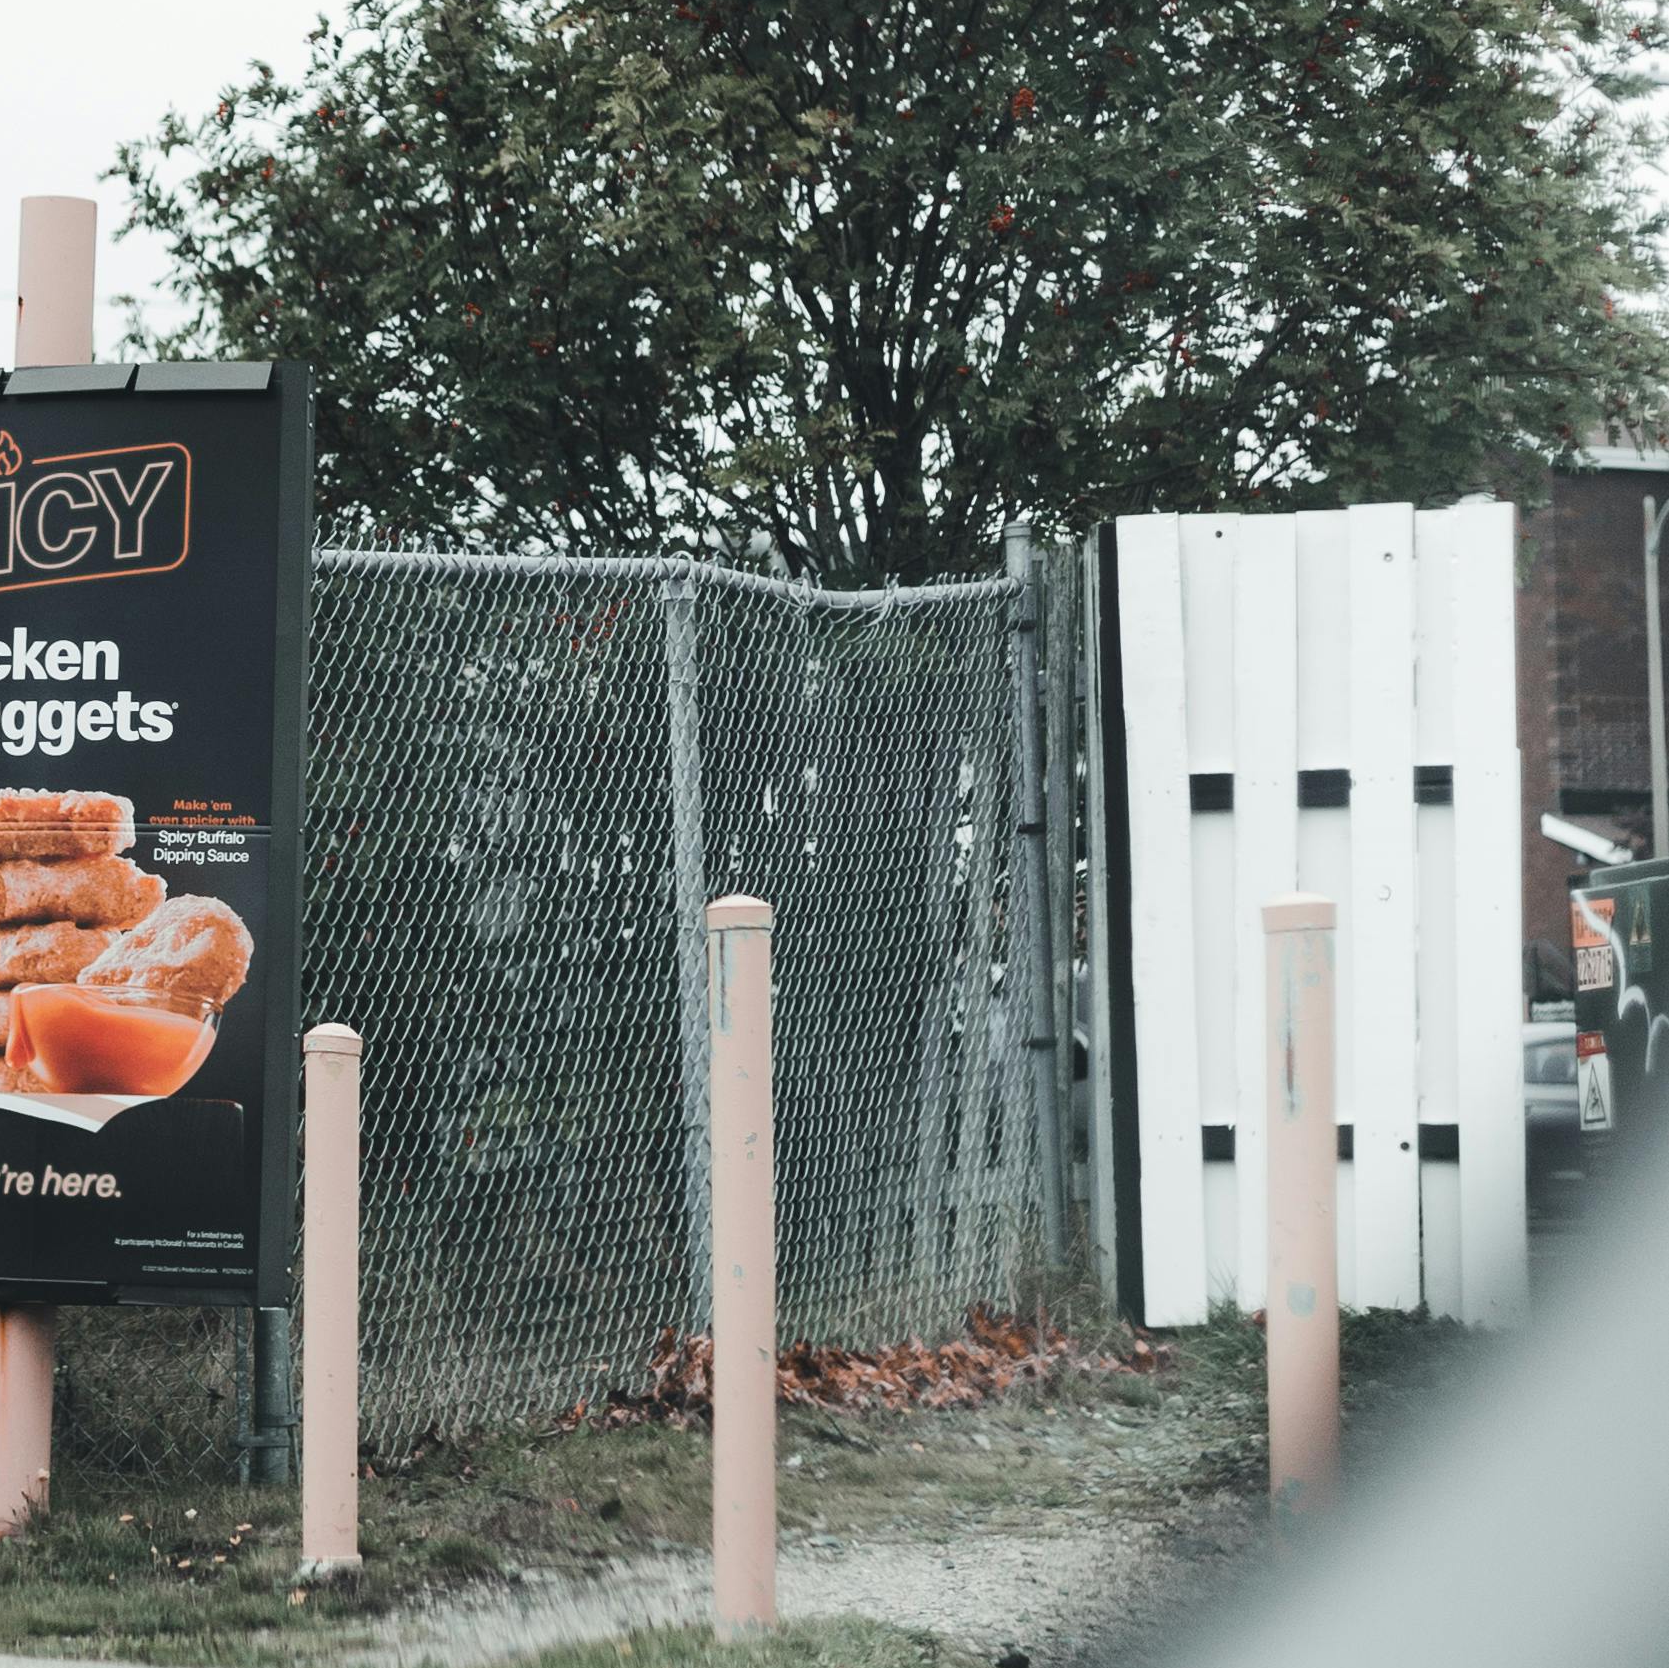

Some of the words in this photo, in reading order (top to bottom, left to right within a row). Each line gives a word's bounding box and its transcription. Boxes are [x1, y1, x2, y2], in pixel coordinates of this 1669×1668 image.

[173, 799, 208, 811] Make
[149, 815, 179, 825] even
[182, 814, 225, 828] spicier
[227, 815, 256, 827] with
[158, 830, 196, 847] Spicy
[197, 831, 246, 845] Buffalo
[153, 847, 205, 866] Dipping
[207, 848, 250, 863] Sauce
[40, 1164, 122, 1198] here.
